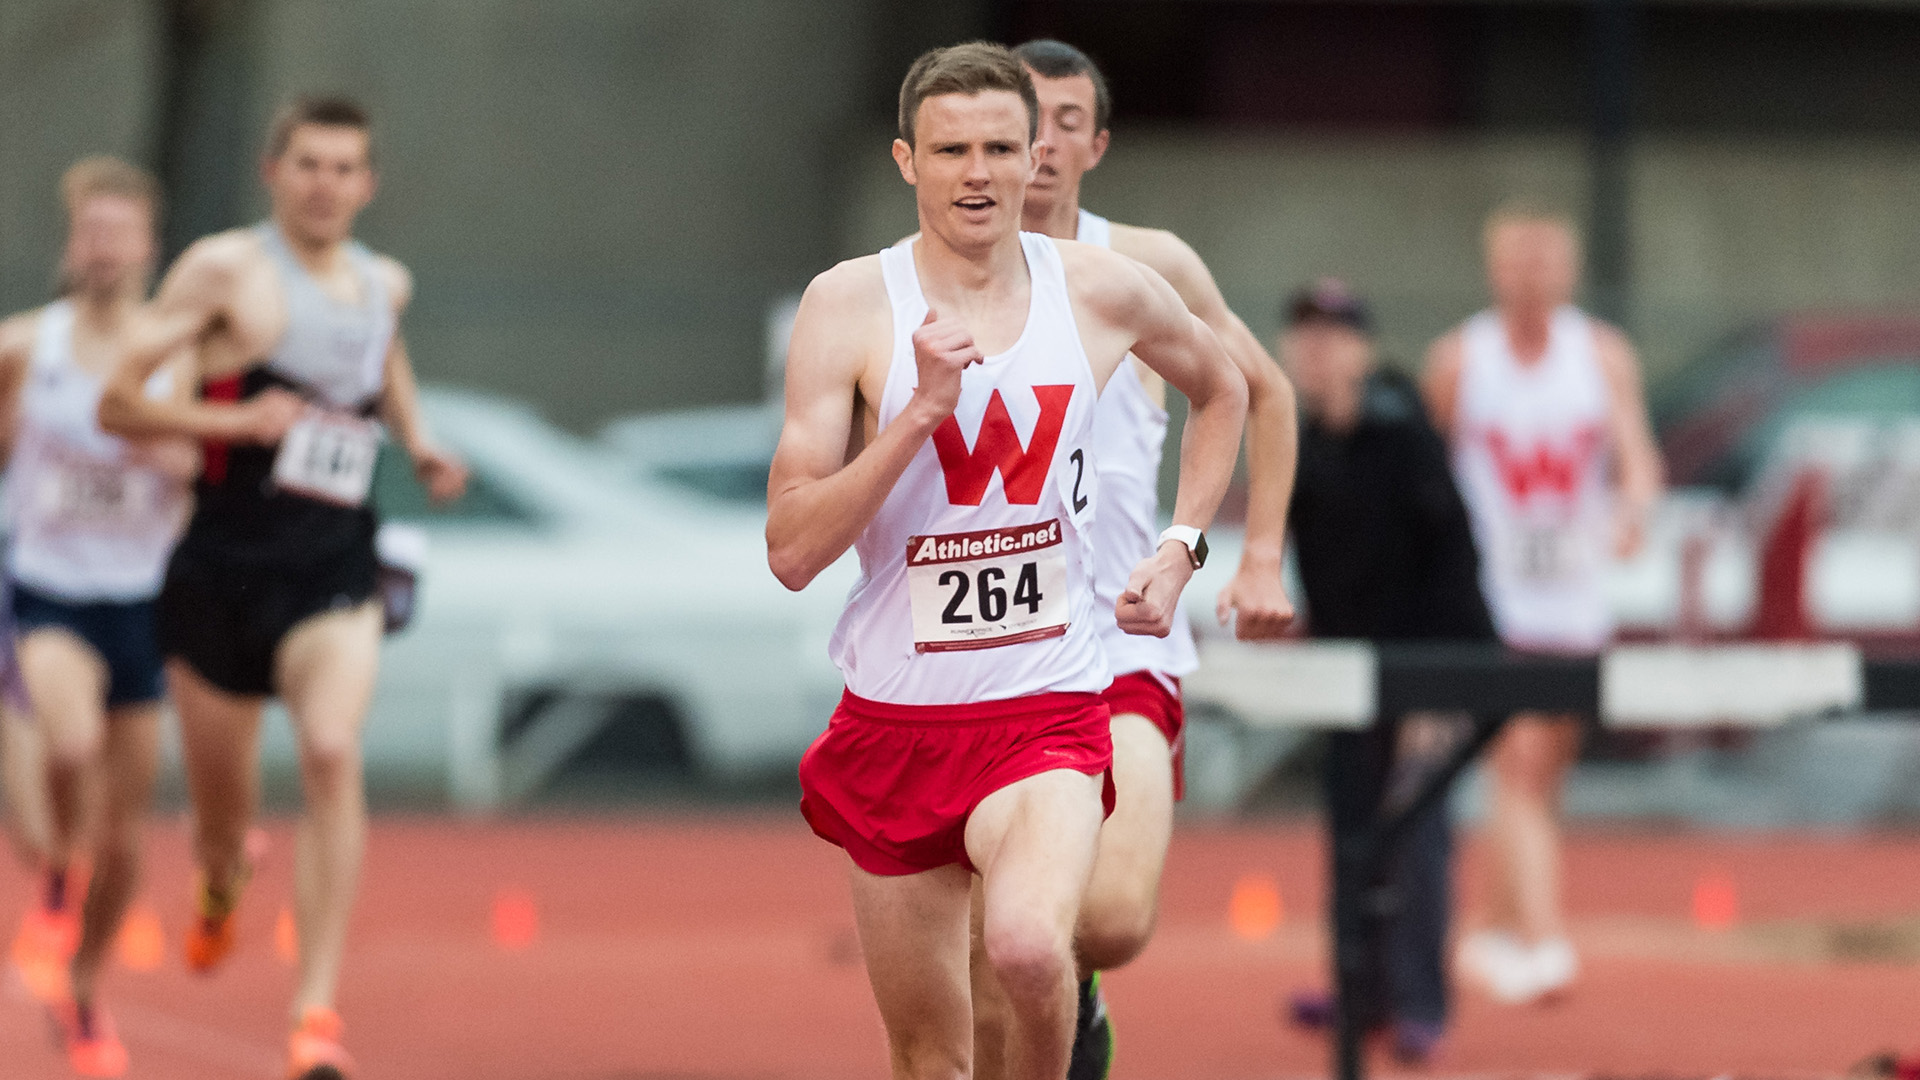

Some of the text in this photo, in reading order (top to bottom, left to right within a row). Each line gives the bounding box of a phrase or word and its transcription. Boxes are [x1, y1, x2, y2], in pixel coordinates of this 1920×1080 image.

[931, 384, 1075, 506] W
[1070, 448, 1087, 514] 2
[912, 523, 1057, 562] Athletic.net
[938, 561, 1043, 624] 264
